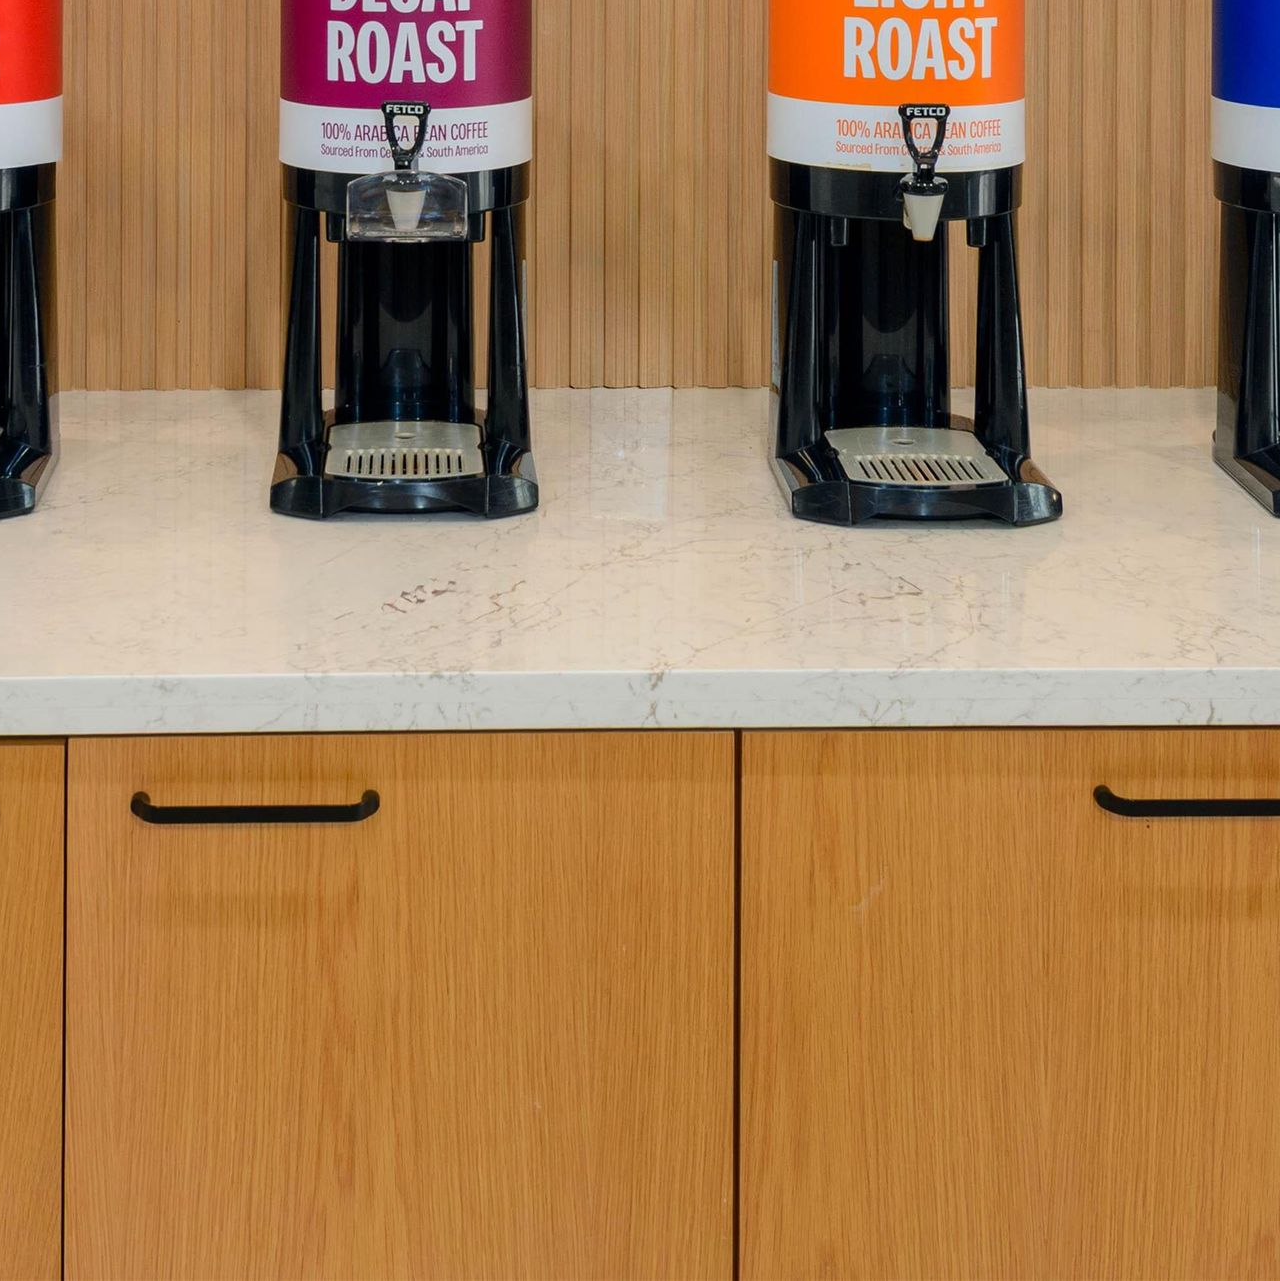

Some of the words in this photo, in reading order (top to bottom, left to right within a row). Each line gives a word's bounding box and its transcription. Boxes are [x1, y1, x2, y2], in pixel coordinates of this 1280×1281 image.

[327, 20, 483, 84] ROAST
[843, 17, 998, 80] ROAST
[386, 104, 424, 115] FETCO
[906, 106, 946, 117] FETCO
[321, 122, 351, 140] 100%
[354, 124, 409, 142] ARABCA
[450, 121, 489, 140] COFFEE
[837, 119, 870, 138] 100%
[970, 118, 1001, 138] COFFEE
[321, 144, 354, 157] Sourced
[355, 145, 378, 158] From
[427, 144, 454, 158] South
[456, 144, 489, 156] America
[836, 141, 873, 154] Sourced
[875, 143, 900, 156] From
[947, 142, 972, 156] South
[973, 142, 1001, 154] America
